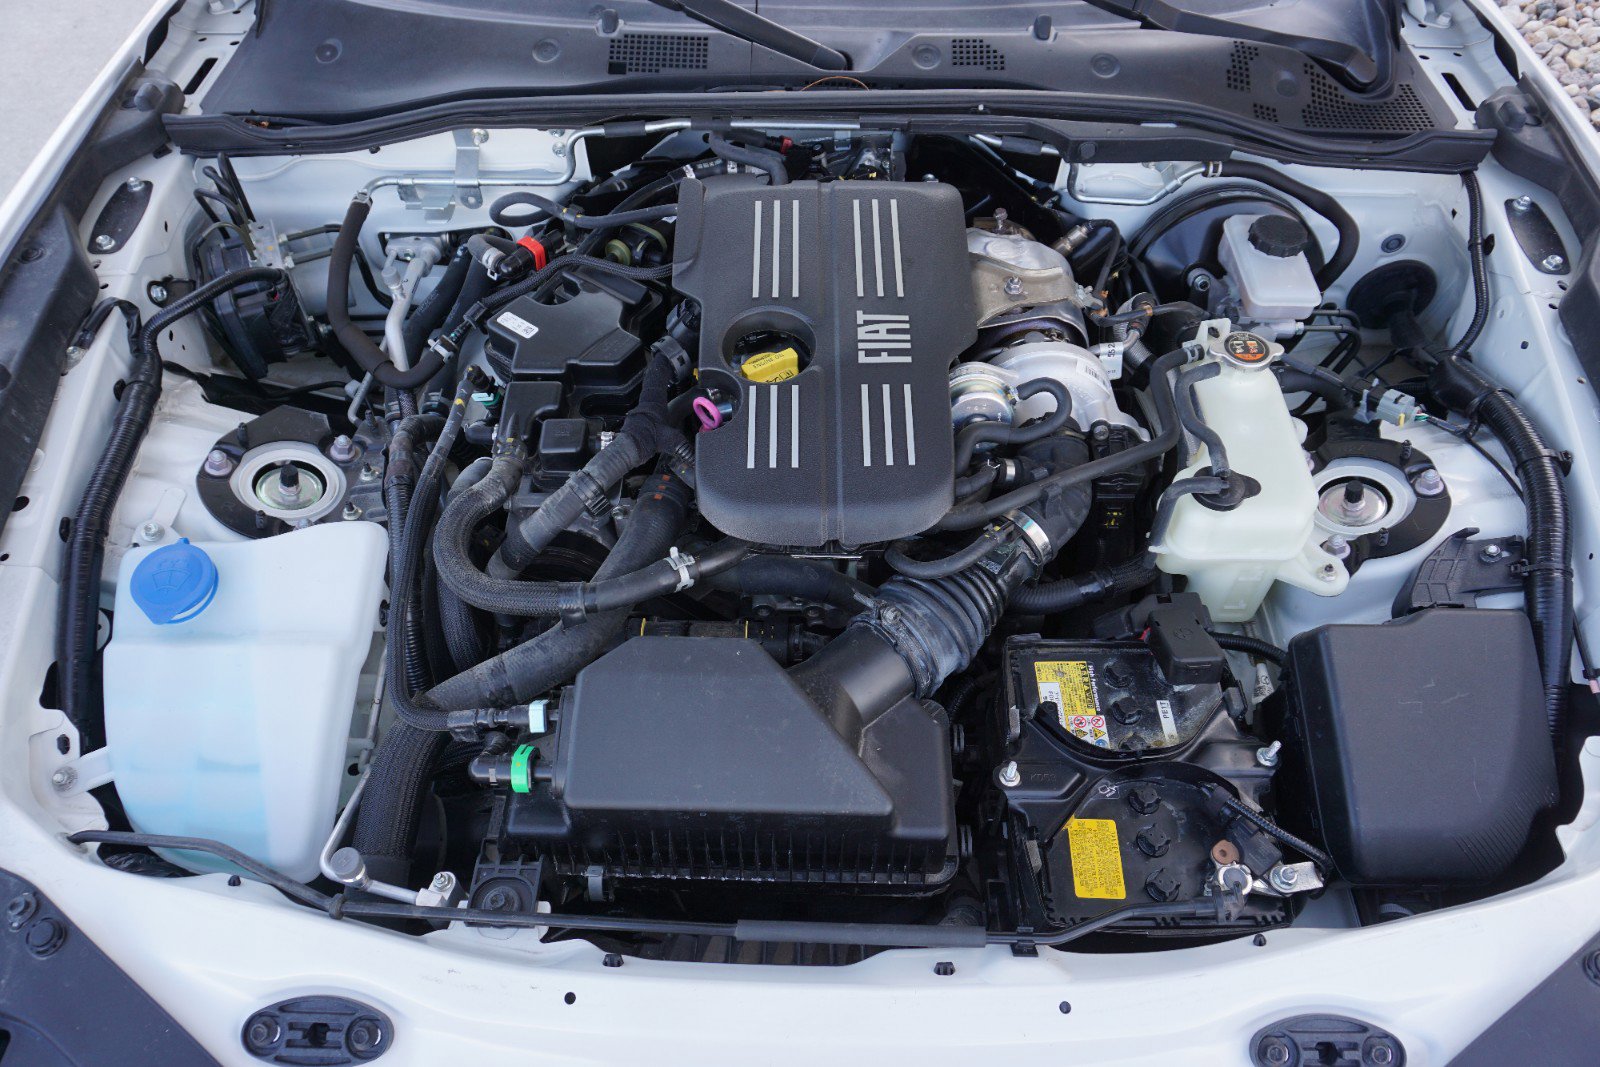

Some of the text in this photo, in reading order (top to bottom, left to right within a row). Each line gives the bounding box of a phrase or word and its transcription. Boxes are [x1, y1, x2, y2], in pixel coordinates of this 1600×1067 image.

[856, 310, 912, 363] FIAT
[1088, 665, 1101, 712] High Performance
